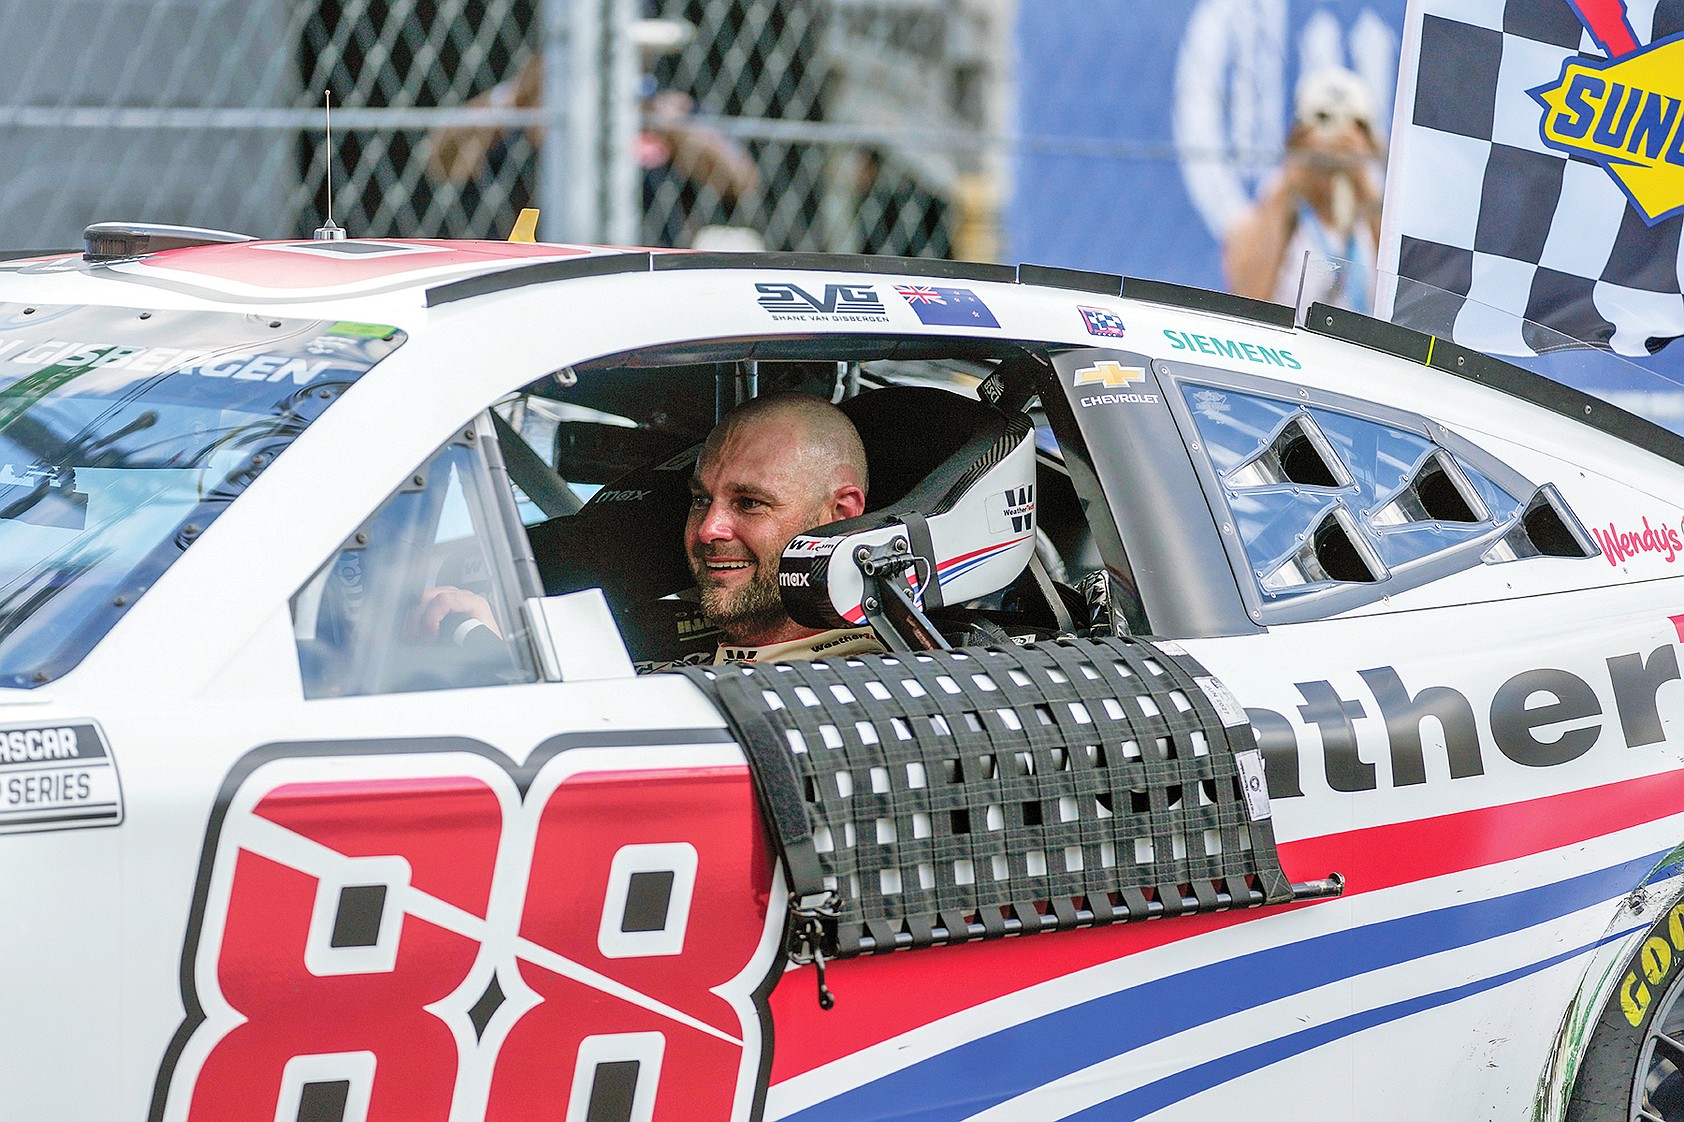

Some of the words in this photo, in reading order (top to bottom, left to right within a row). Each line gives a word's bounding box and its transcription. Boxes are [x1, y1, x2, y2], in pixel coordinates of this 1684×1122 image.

[754, 283, 880, 314] SVG
[772, 314, 807, 322] SHANE
[832, 315, 890, 323] GISBERGEN
[13, 341, 332, 386] GISBERGEN
[1163, 329, 1302, 370] SIEMENS
[1081, 394, 1159, 408] CHEVROLET
[595, 489, 652, 504] max
[1592, 515, 1683, 567] Wendy's
[779, 572, 810, 587] max
[9, 773, 90, 804] SERIES
[165, 742, 781, 1122] 88
